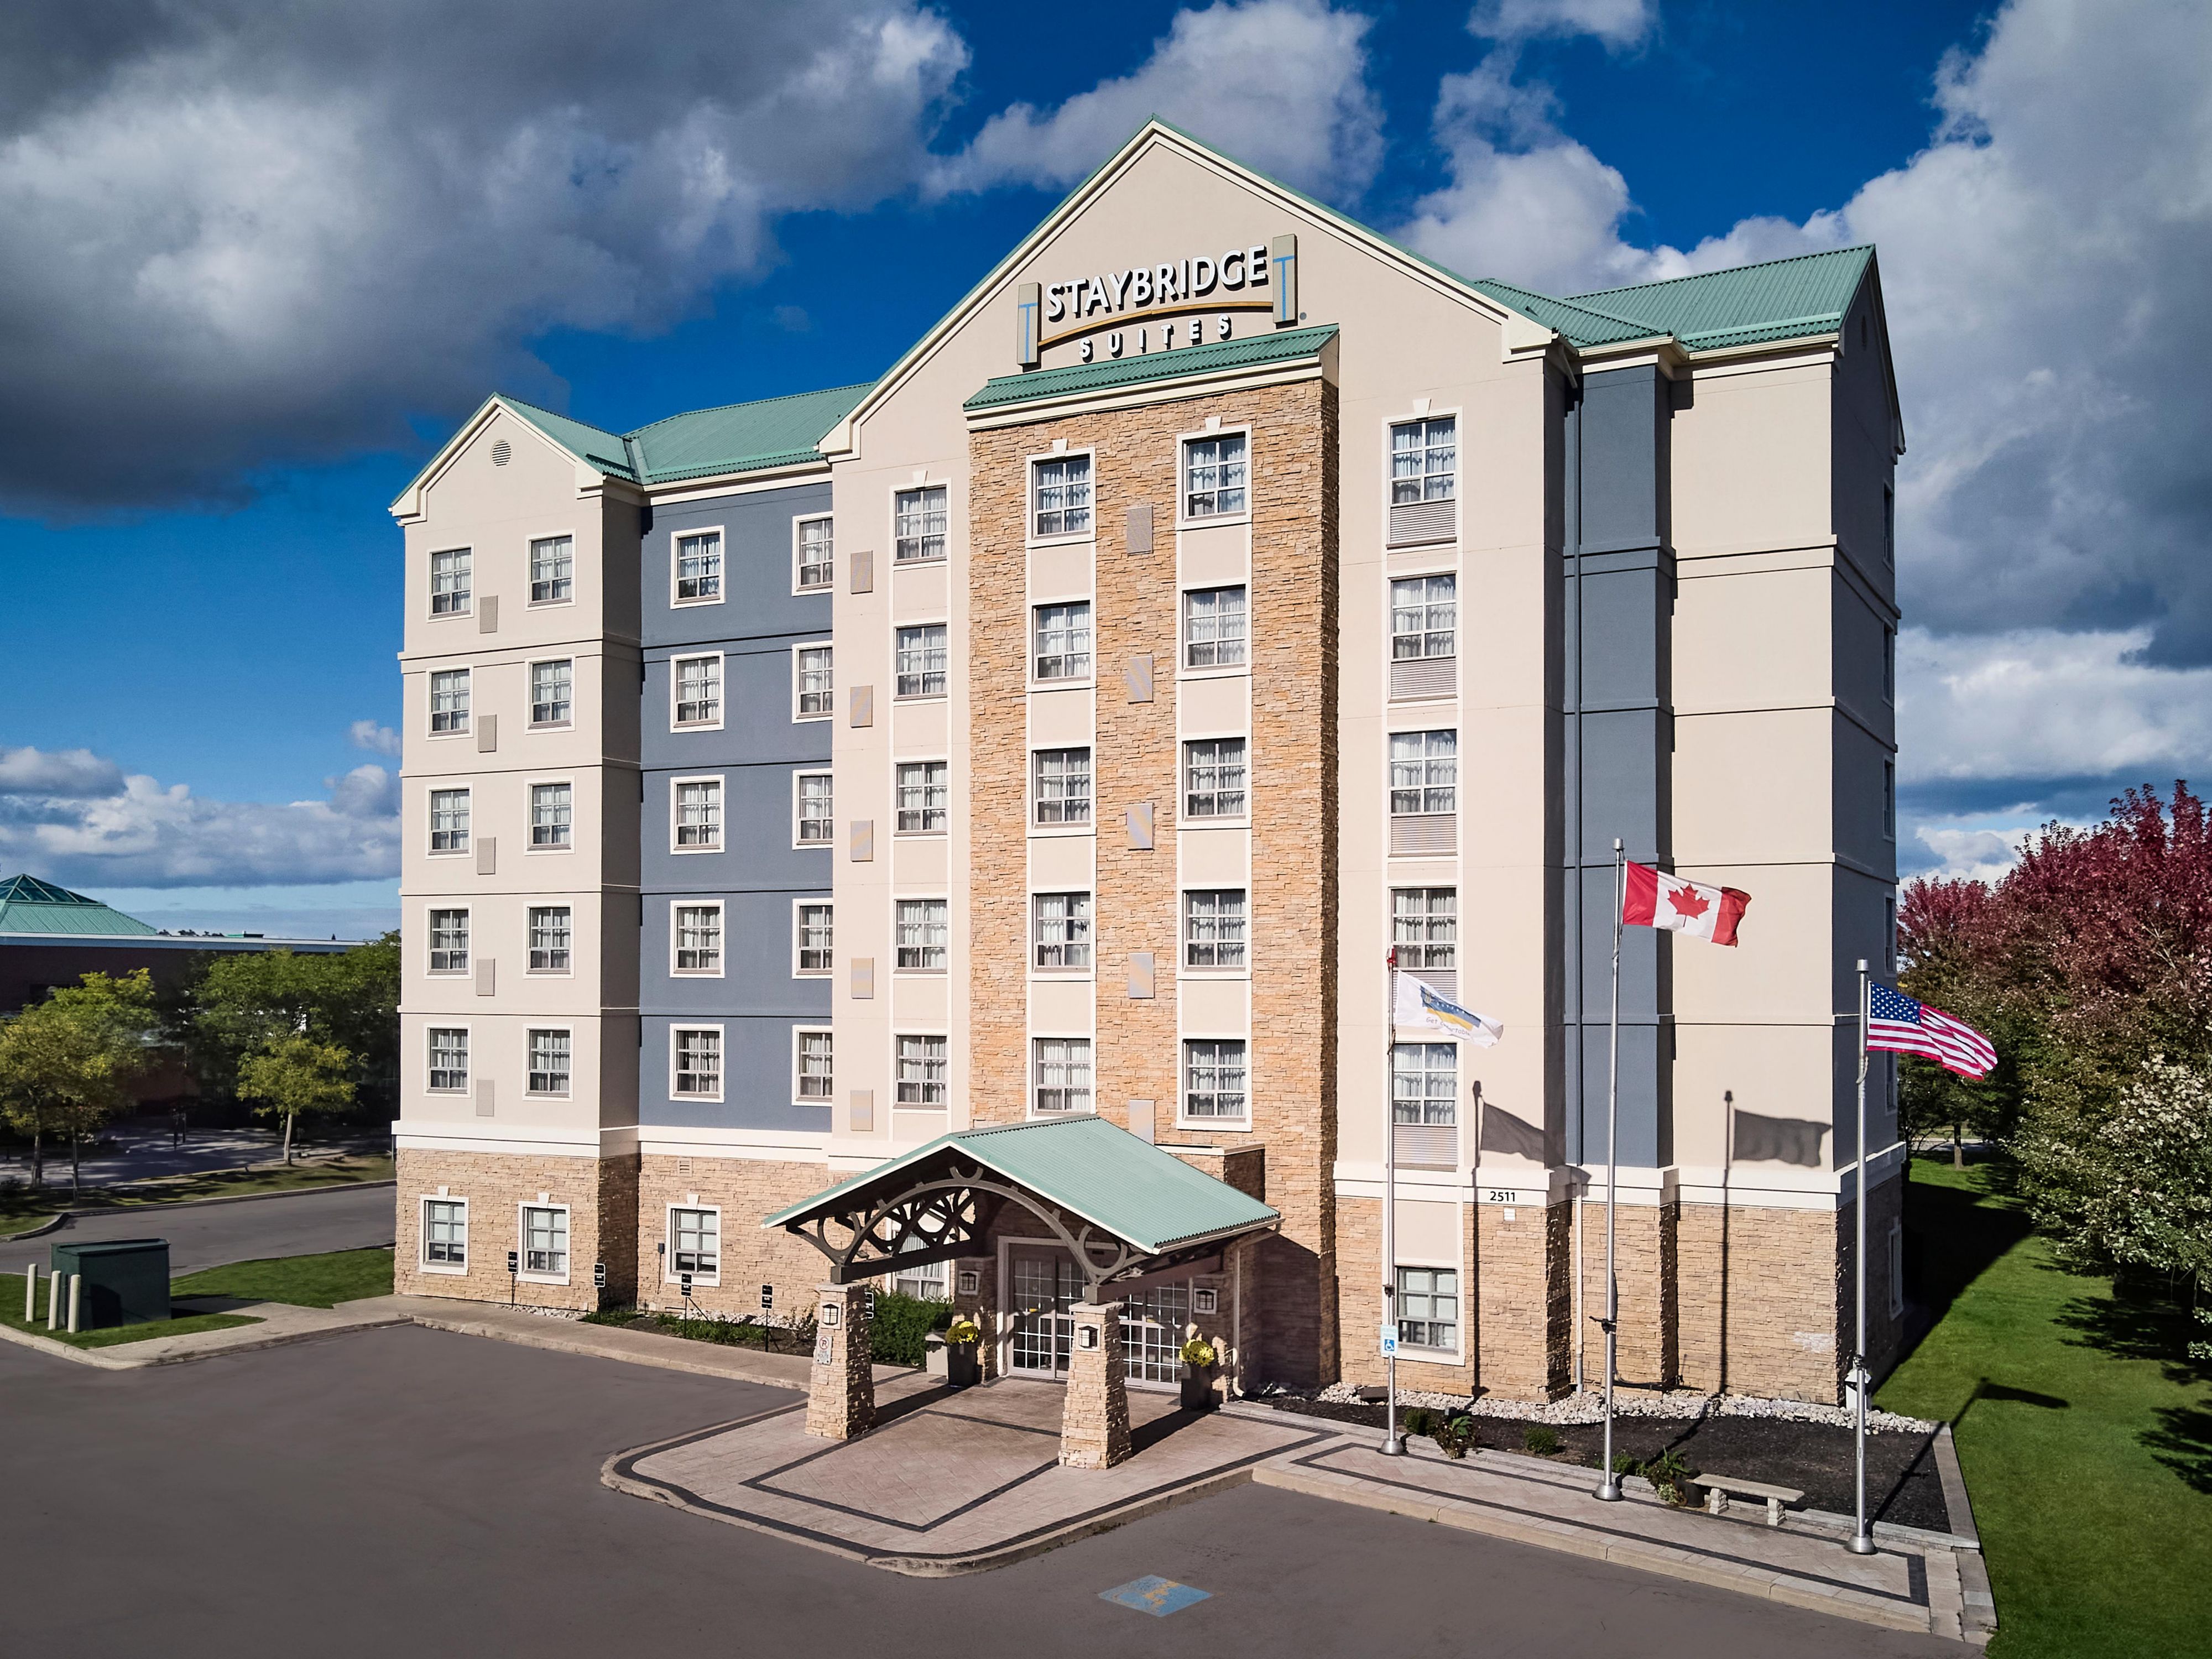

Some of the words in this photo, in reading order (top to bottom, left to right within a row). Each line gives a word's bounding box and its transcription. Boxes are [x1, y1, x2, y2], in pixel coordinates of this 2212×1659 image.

[1045, 244, 1268, 320] STAYBRIDGE
[1079, 314, 1231, 361] SUITES
[1490, 1191, 1515, 1202] 2511
